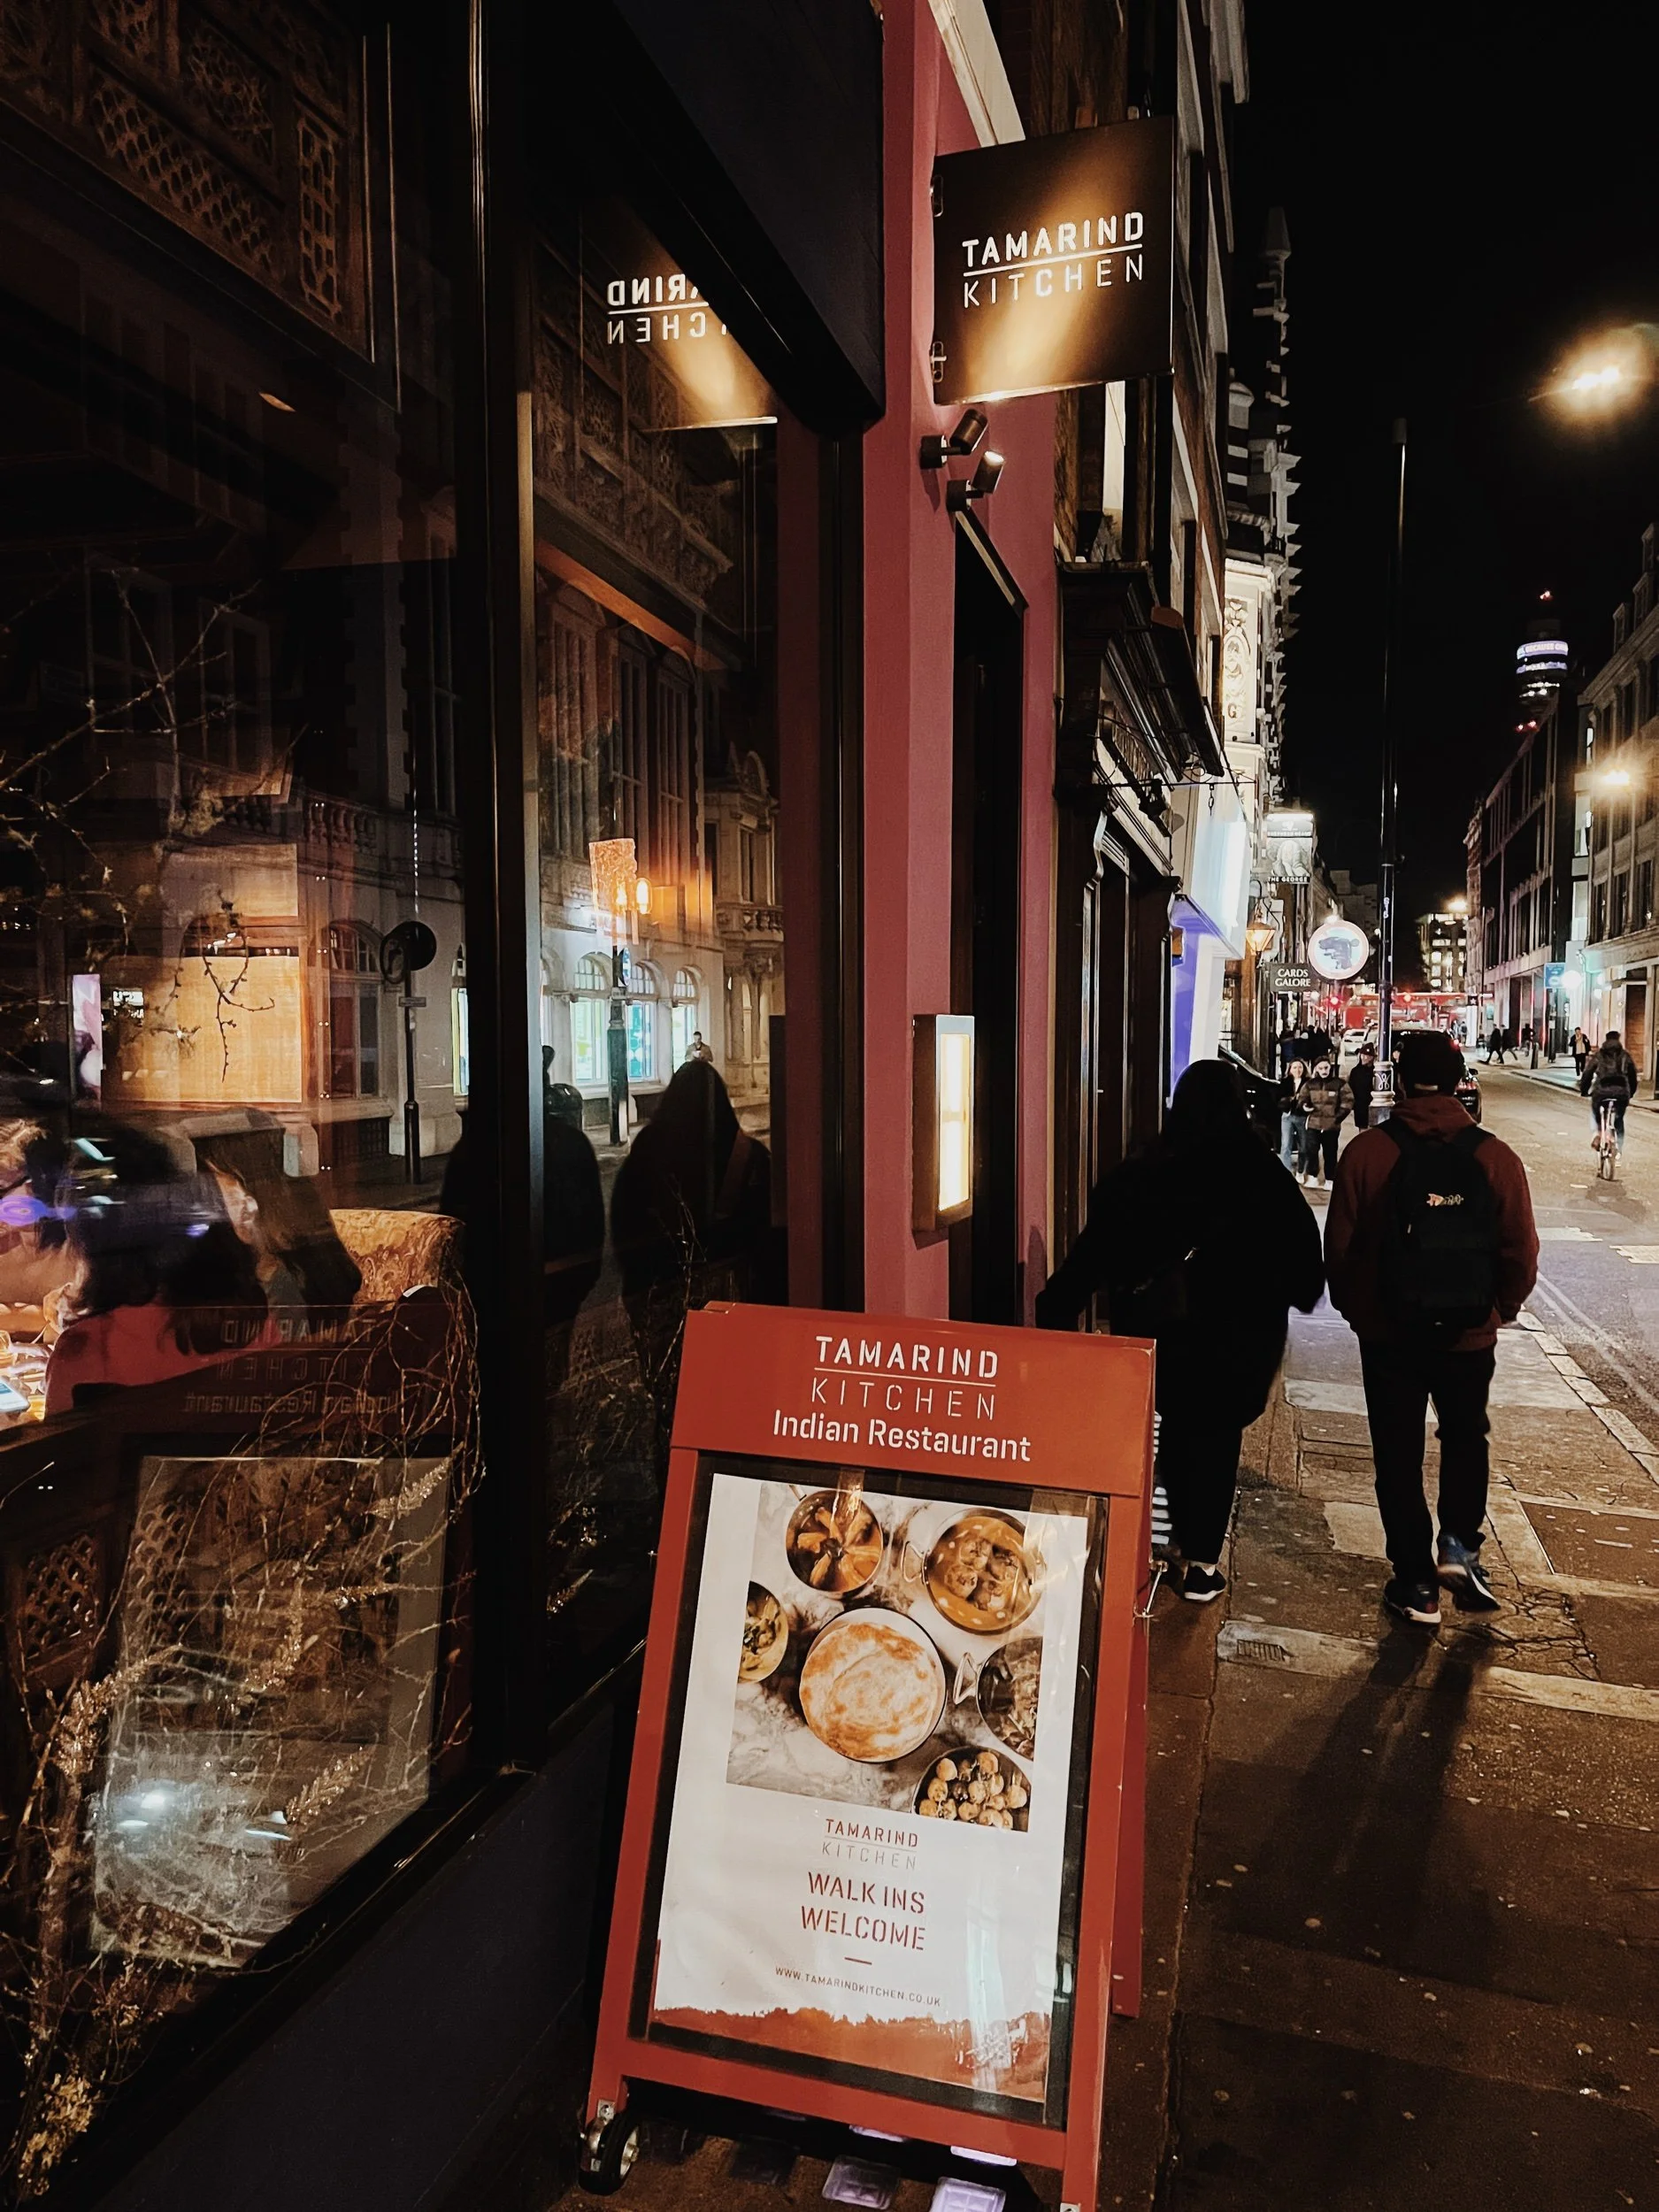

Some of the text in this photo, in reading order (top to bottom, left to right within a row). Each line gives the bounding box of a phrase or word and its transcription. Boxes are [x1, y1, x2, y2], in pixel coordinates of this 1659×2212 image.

[962, 211, 1143, 267] TAMARIND
[964, 253, 1143, 308] KITCHEN
[1274, 978, 1311, 987] GALORE
[1277, 968, 1309, 978] CARDS
[815, 1335, 999, 1379] TAMARIND
[810, 1377, 995, 1421] KITCHEN
[772, 1409, 1032, 1462] Indian Restaurant
[825, 1818, 918, 1847] TAMARIND
[822, 1841, 917, 1870] KITCHEN
[801, 1905, 926, 1951] WELCOME
[775, 1967, 941, 2007] WWW.TAMARINDKITCHEN.CO.UK
